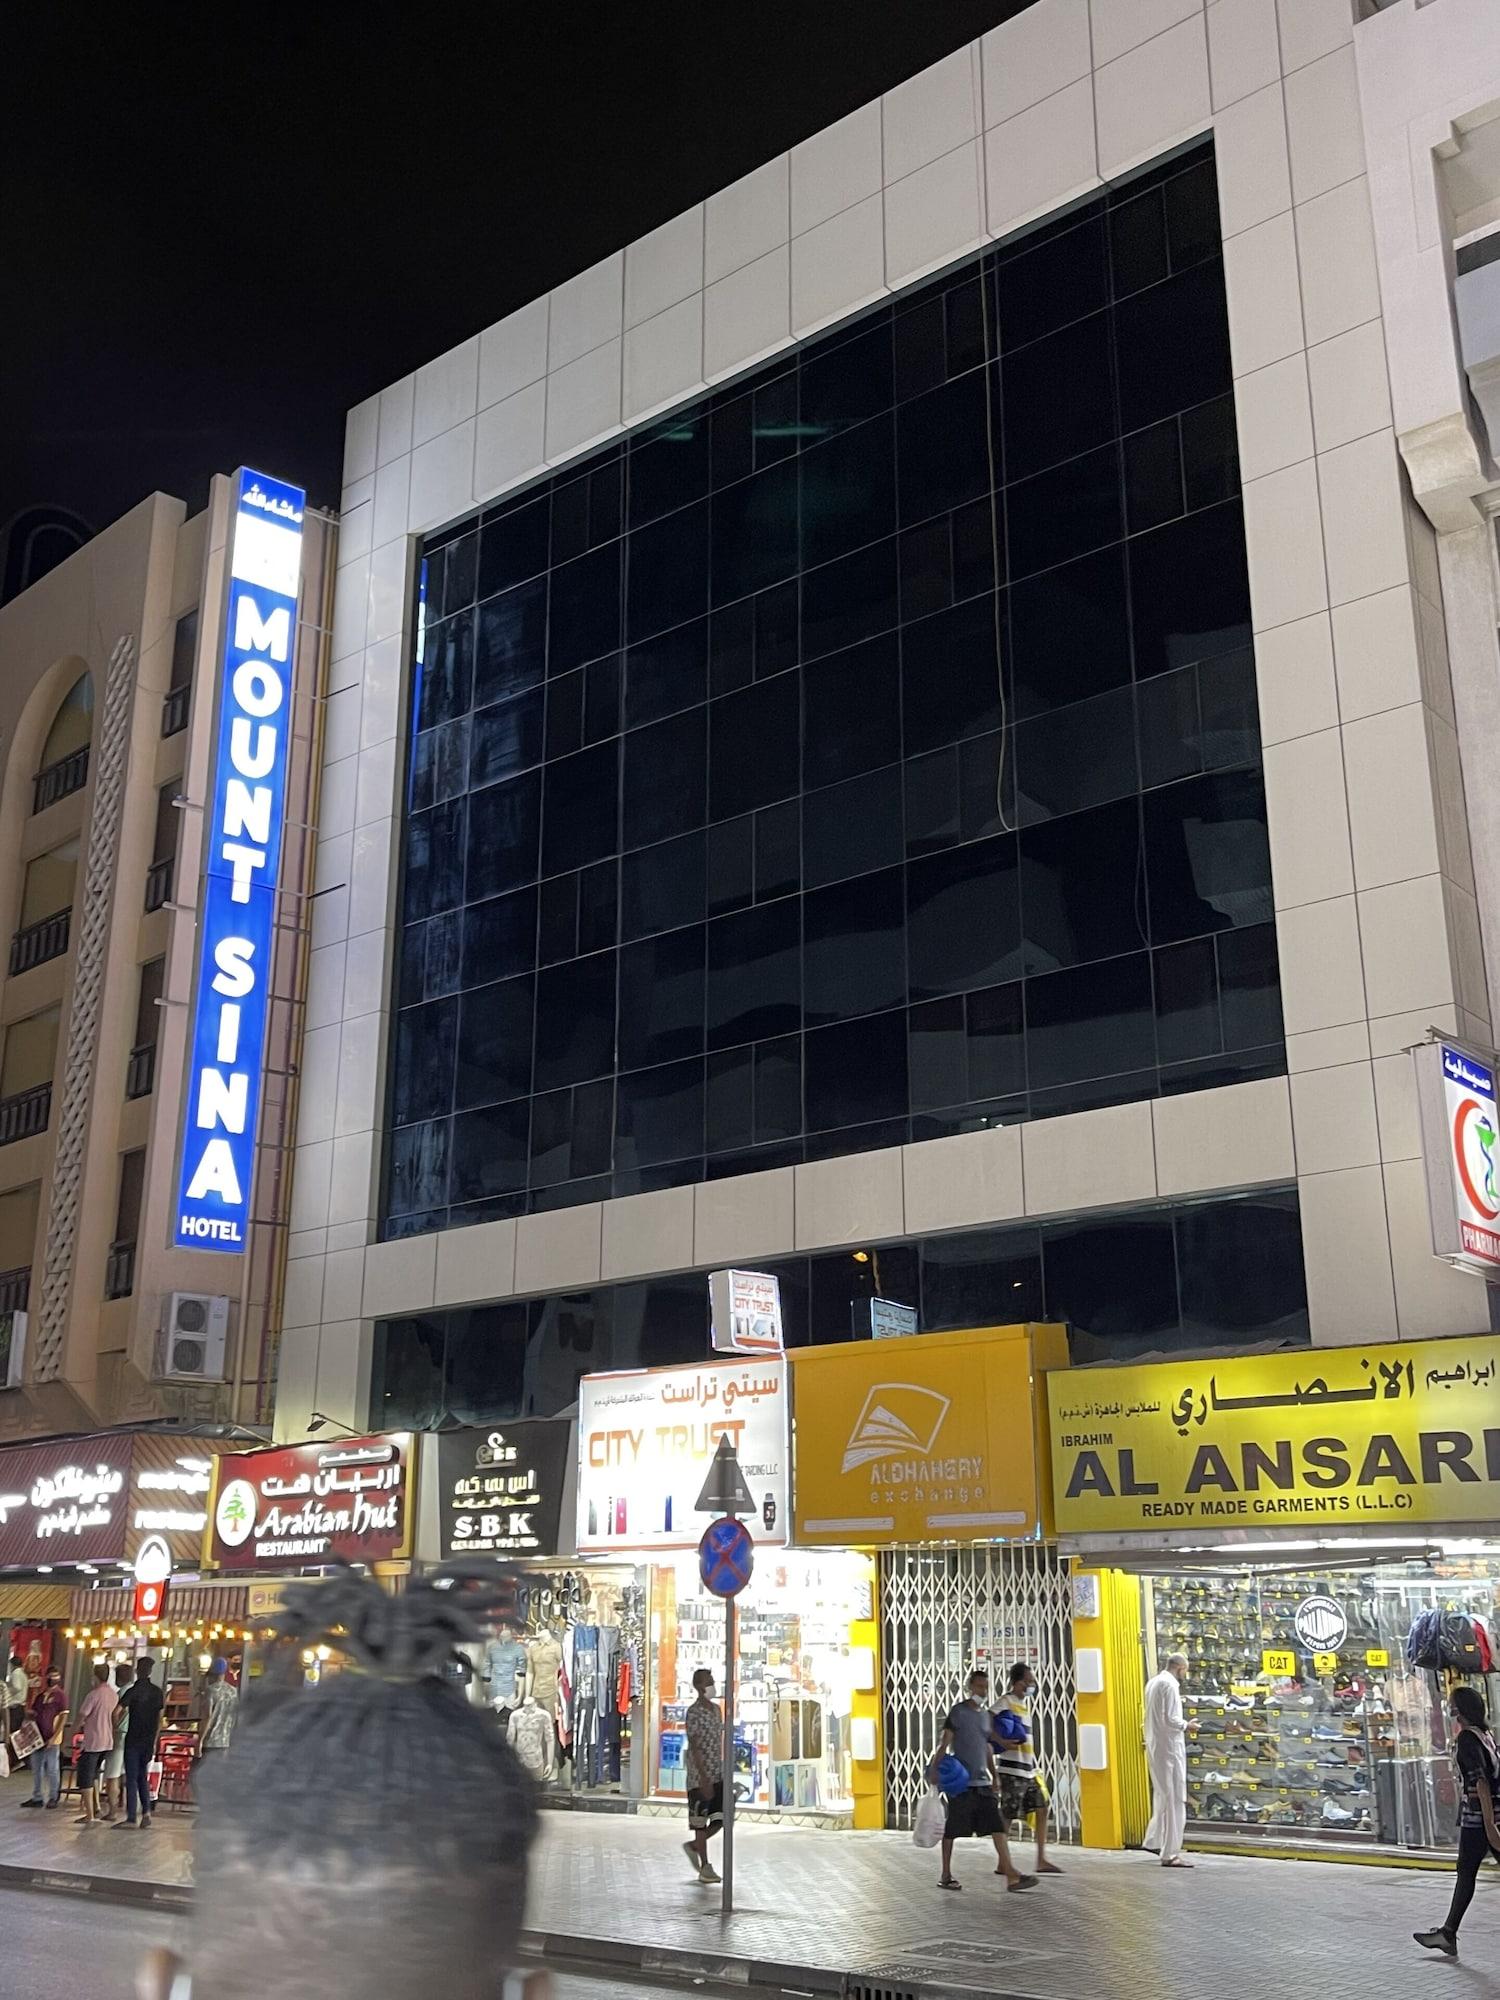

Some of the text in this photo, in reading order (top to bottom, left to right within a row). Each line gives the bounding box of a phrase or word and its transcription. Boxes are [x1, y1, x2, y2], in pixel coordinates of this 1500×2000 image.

[222, 595, 290, 904] MOUNT
[186, 936, 256, 1204] SINA
[1444, 1052, 1491, 1091] صيدلية
[181, 1215, 242, 1242] HOTEL
[752, 1299, 774, 1312] TRUST
[661, 1373, 779, 1414] سيتي تراست
[589, 1428, 644, 1478] CITY
[1061, 1433, 1113, 1447] IBRAHIM
[1065, 1428, 1500, 1498] AL ANSARI
[870, 1487, 983, 1504] exchange
[1142, 1502, 1194, 1517] READY
[1201, 1499, 1247, 1515] MADE
[1253, 1495, 1350, 1513] GARMENTS
[254, 1499, 350, 1538] Arabian
[255, 1539, 326, 1557] RESTAURANT
[1270, 1656, 1288, 1670] CAT
